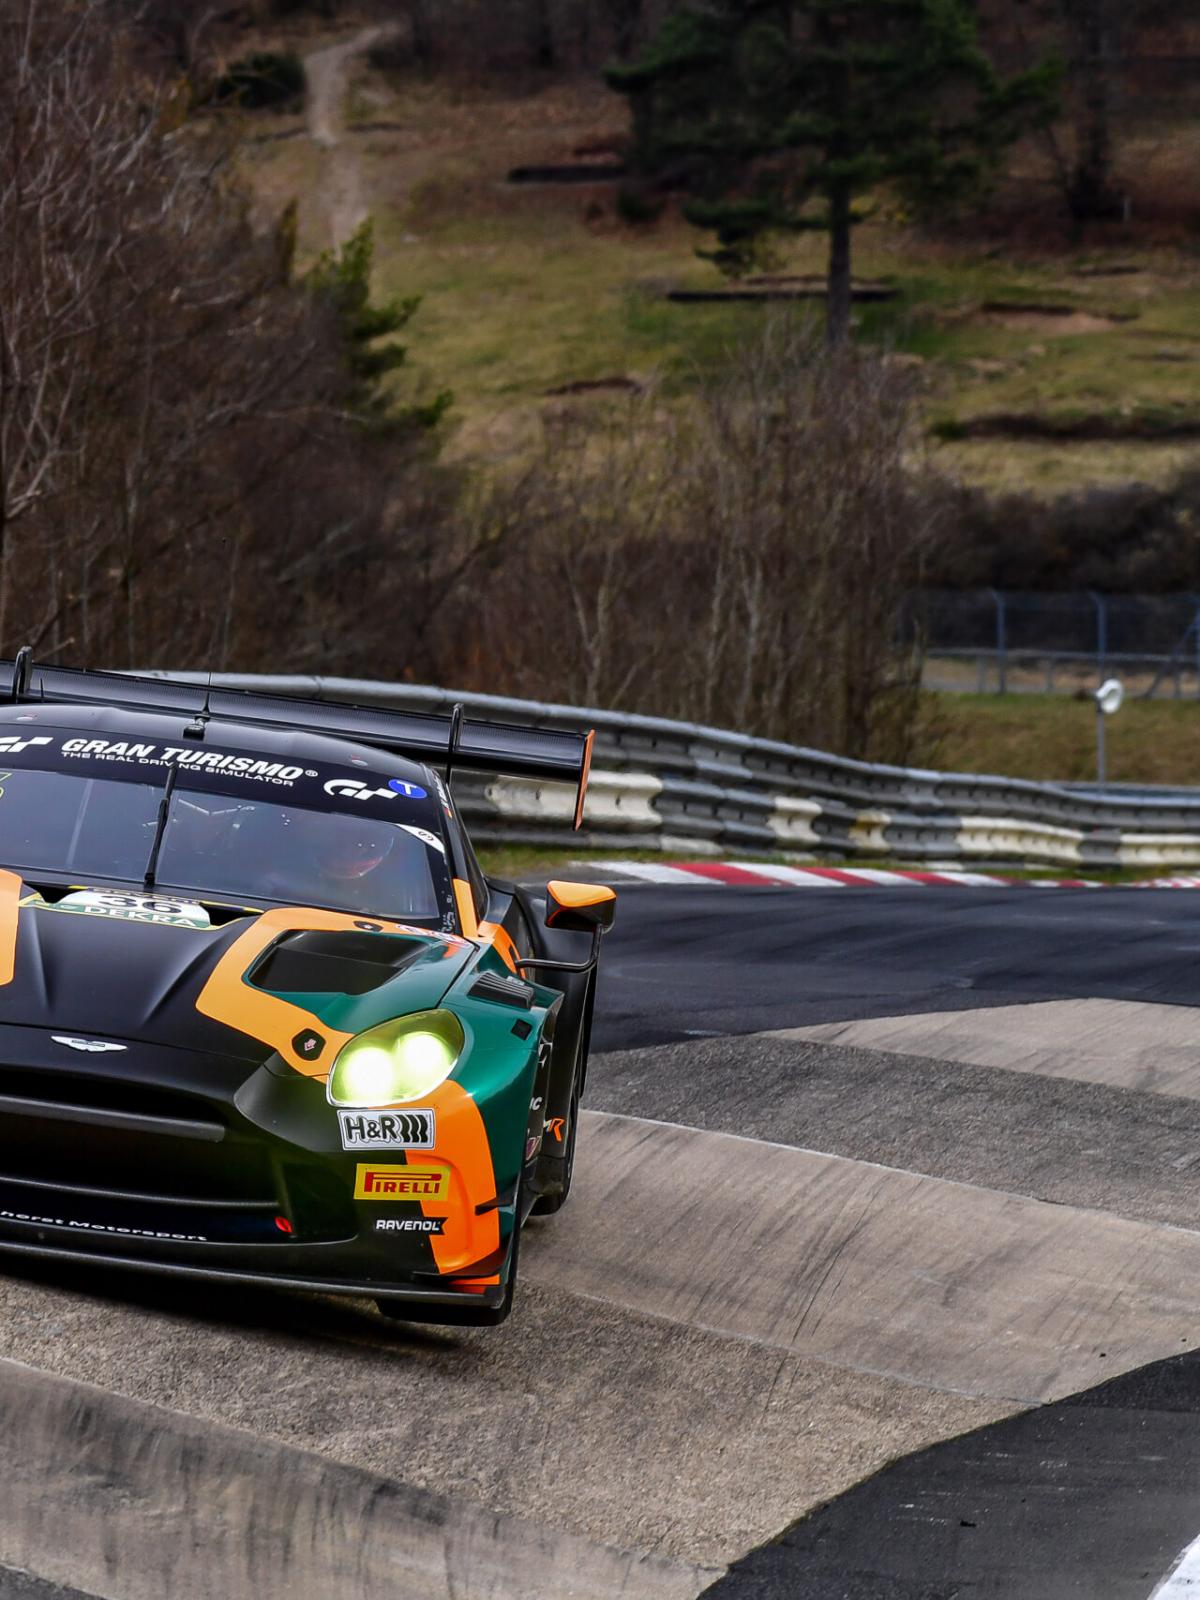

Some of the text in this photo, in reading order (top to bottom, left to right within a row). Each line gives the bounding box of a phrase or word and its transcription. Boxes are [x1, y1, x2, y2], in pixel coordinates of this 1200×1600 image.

[61, 738, 156, 758] GRAN
[61, 751, 294, 788] THE REAL DRIVNG SIMULATOR
[99, 894, 182, 914] 36
[83, 905, 197, 928] DEKRA
[363, 1171, 443, 1194] PIRELLI
[69, 1220, 208, 1241] Motorsport
[375, 1219, 441, 1231] RAVENOL
